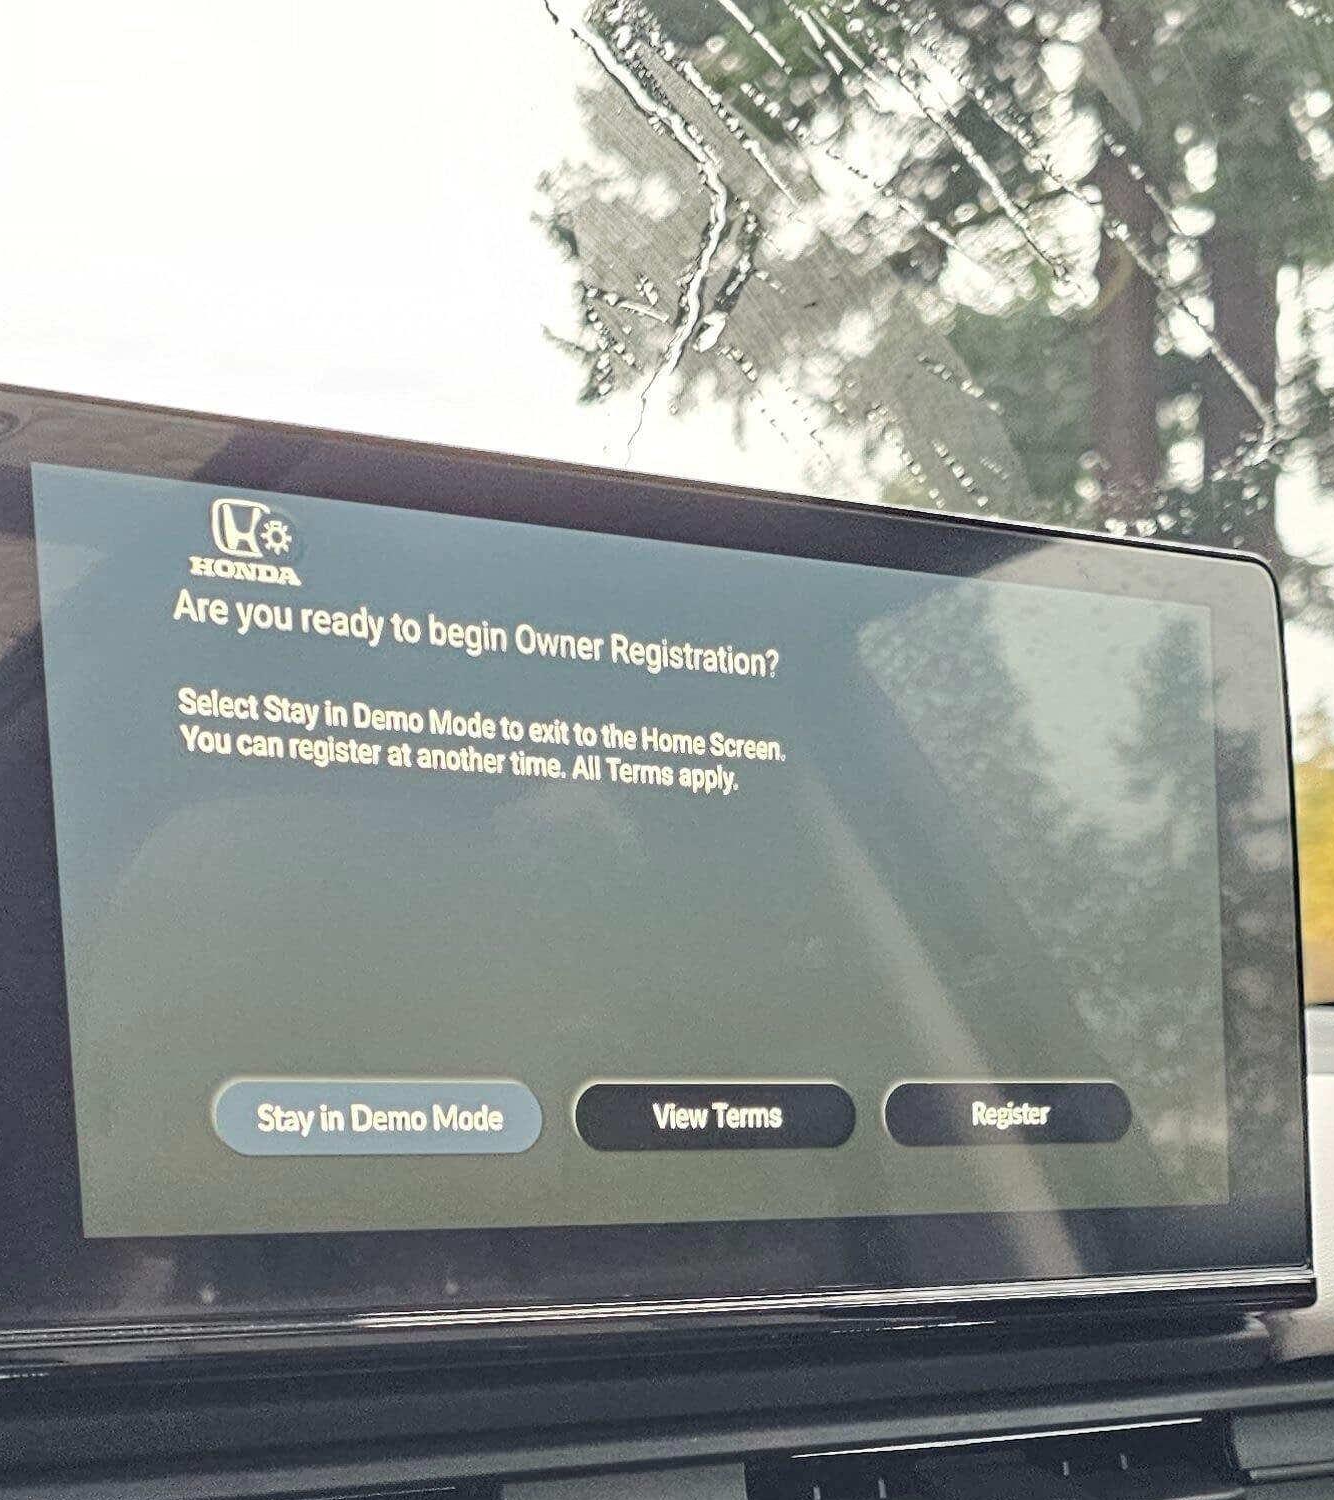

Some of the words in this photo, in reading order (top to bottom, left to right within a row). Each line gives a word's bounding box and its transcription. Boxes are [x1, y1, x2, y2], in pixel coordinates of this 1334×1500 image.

[188, 556, 303, 587] HONDA
[173, 588, 229, 626] Are
[235, 602, 293, 635] you
[300, 606, 385, 648] ready
[390, 612, 422, 644] to
[428, 613, 508, 657] begin
[515, 623, 605, 661] Owner
[610, 633, 781, 679] Registration?
[178, 687, 260, 721] Select
[263, 694, 320, 731] Stay
[324, 699, 348, 728] in
[352, 701, 424, 734] Demo
[428, 708, 496, 740] Mode
[499, 716, 525, 742] to
[528, 717, 570, 746] exit
[572, 722, 598, 748] to
[600, 723, 638, 751] the
[641, 726, 706, 756] Home
[709, 731, 787, 763] Screen.
[179, 724, 232, 755] You
[236, 734, 284, 759] can
[289, 735, 382, 768] register
[387, 743, 413, 768] at
[416, 745, 506, 774] another
[509, 750, 567, 780] time.
[572, 754, 602, 781] All
[605, 757, 674, 787] Terms
[678, 764, 739, 796] apply.
[257, 1103, 315, 1138] Stay
[320, 1104, 345, 1132] in
[350, 1103, 428, 1132] Demo
[432, 1103, 504, 1132] Mode
[652, 1102, 709, 1130] View
[711, 1102, 783, 1130] Terms
[971, 1101, 1052, 1131] Register
